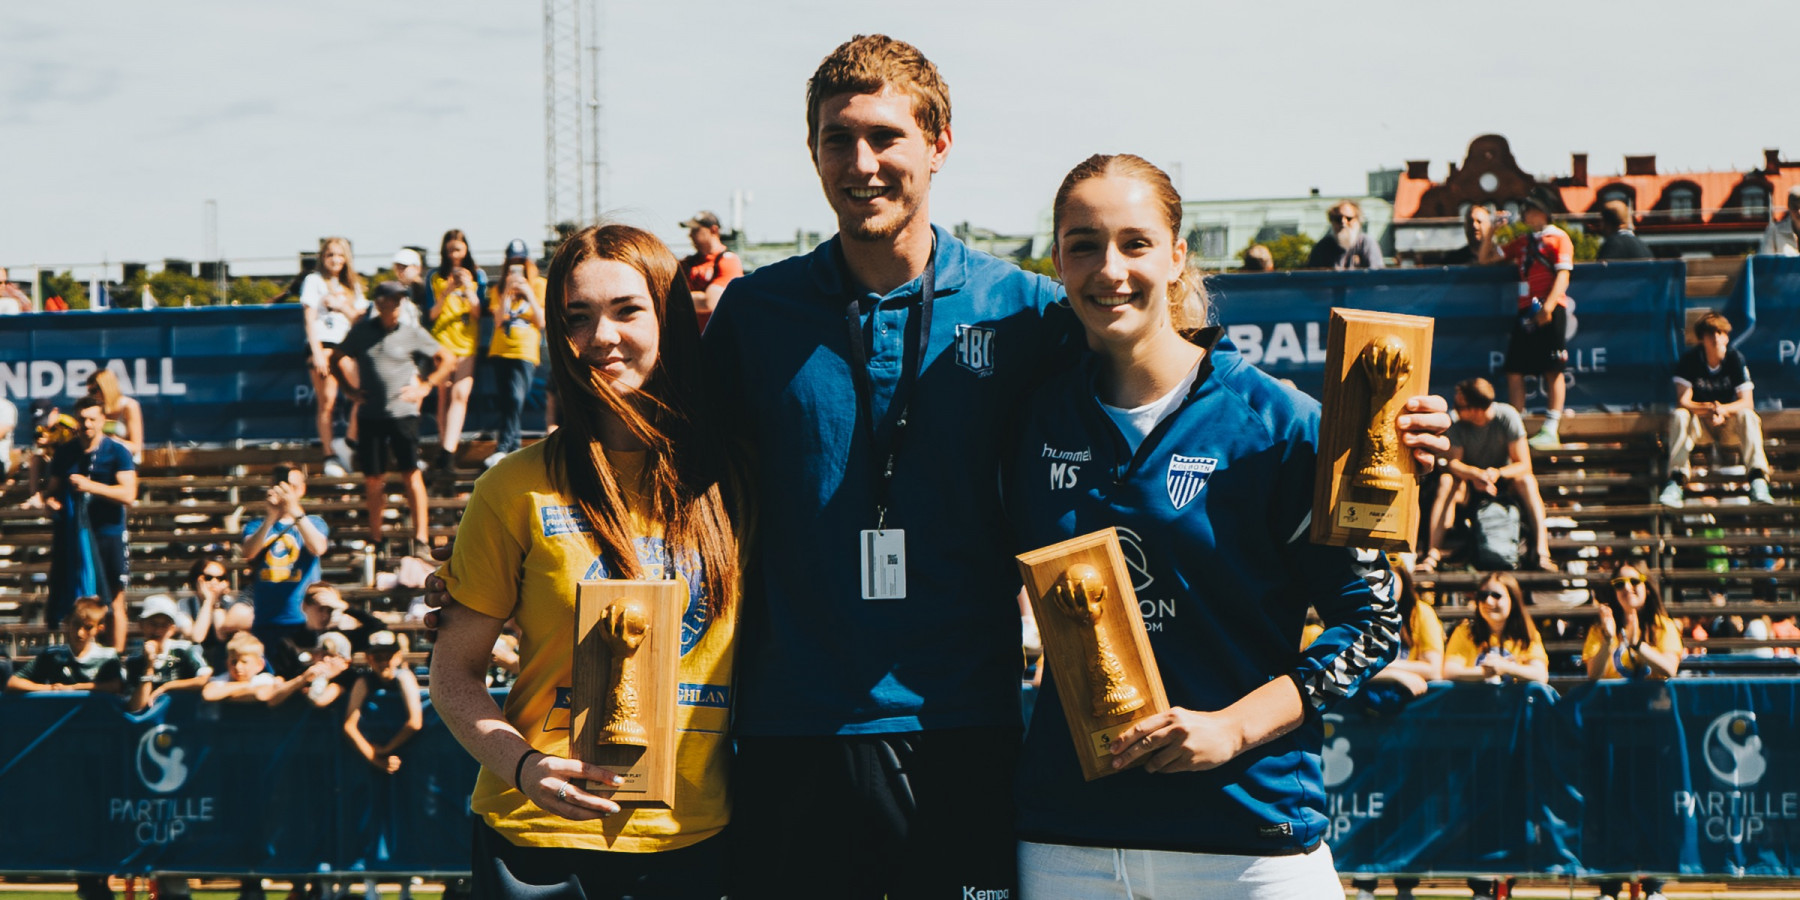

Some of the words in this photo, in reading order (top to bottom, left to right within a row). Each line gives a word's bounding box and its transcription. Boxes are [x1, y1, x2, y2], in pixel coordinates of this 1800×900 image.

[1041, 443, 1092, 462] hummel
[1050, 462, 1081, 490] MS
[110, 797, 214, 822] PARTILLE
[1674, 790, 1798, 818] PARTILLE
[136, 819, 186, 845] CUP
[1705, 815, 1764, 844] CUP
[962, 885, 1009, 900] Kempa
